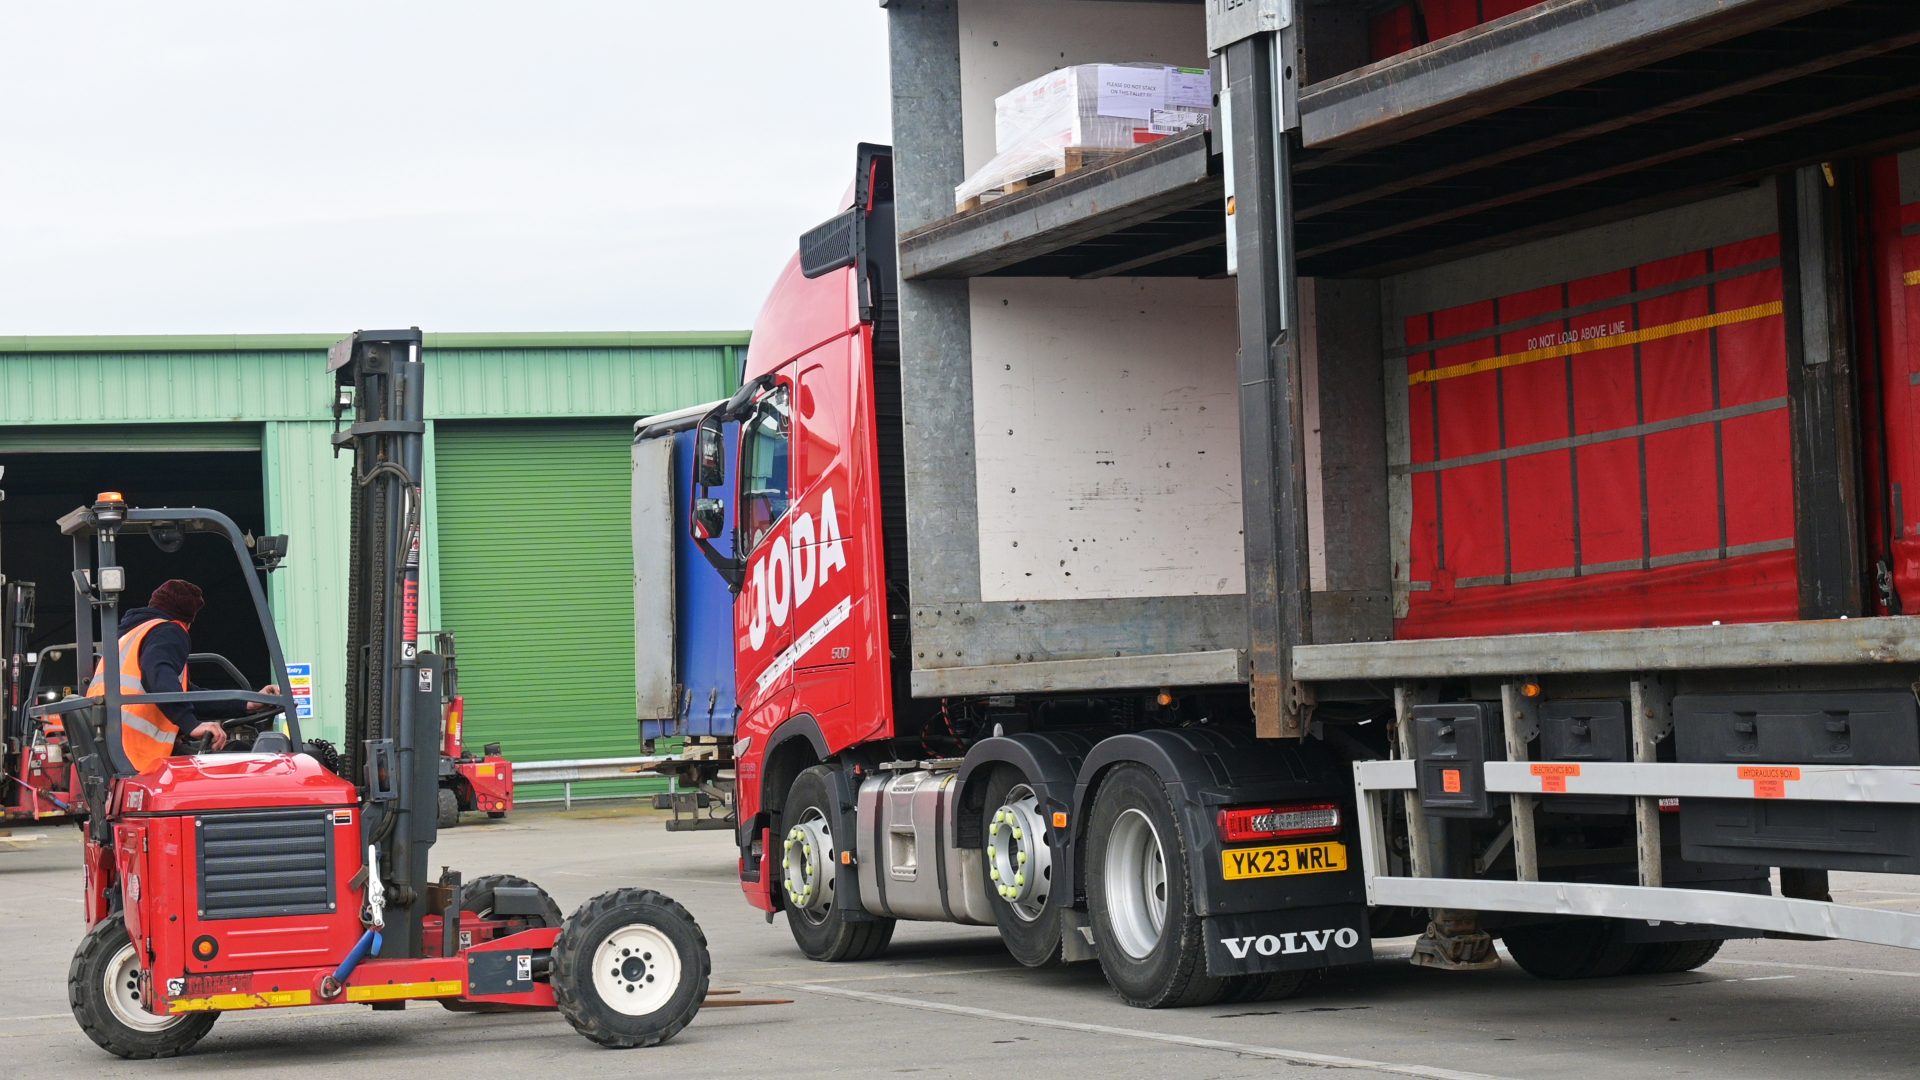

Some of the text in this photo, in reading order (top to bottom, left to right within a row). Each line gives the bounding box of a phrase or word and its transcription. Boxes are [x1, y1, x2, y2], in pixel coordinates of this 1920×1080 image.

[1214, 0, 1251, 15] TIG
[1527, 320, 1626, 350] DO NOT LOAD ABOVE LINE
[749, 486, 847, 652] JODA
[403, 578, 417, 641] MOFFETT
[831, 647, 851, 660] 500
[1533, 766, 1565, 774] ELECTRONICS
[1743, 768, 1793, 778] HYDRAULICS BOX
[1232, 846, 1338, 875] YK23 WRL
[1220, 927, 1359, 959] VOLVO
